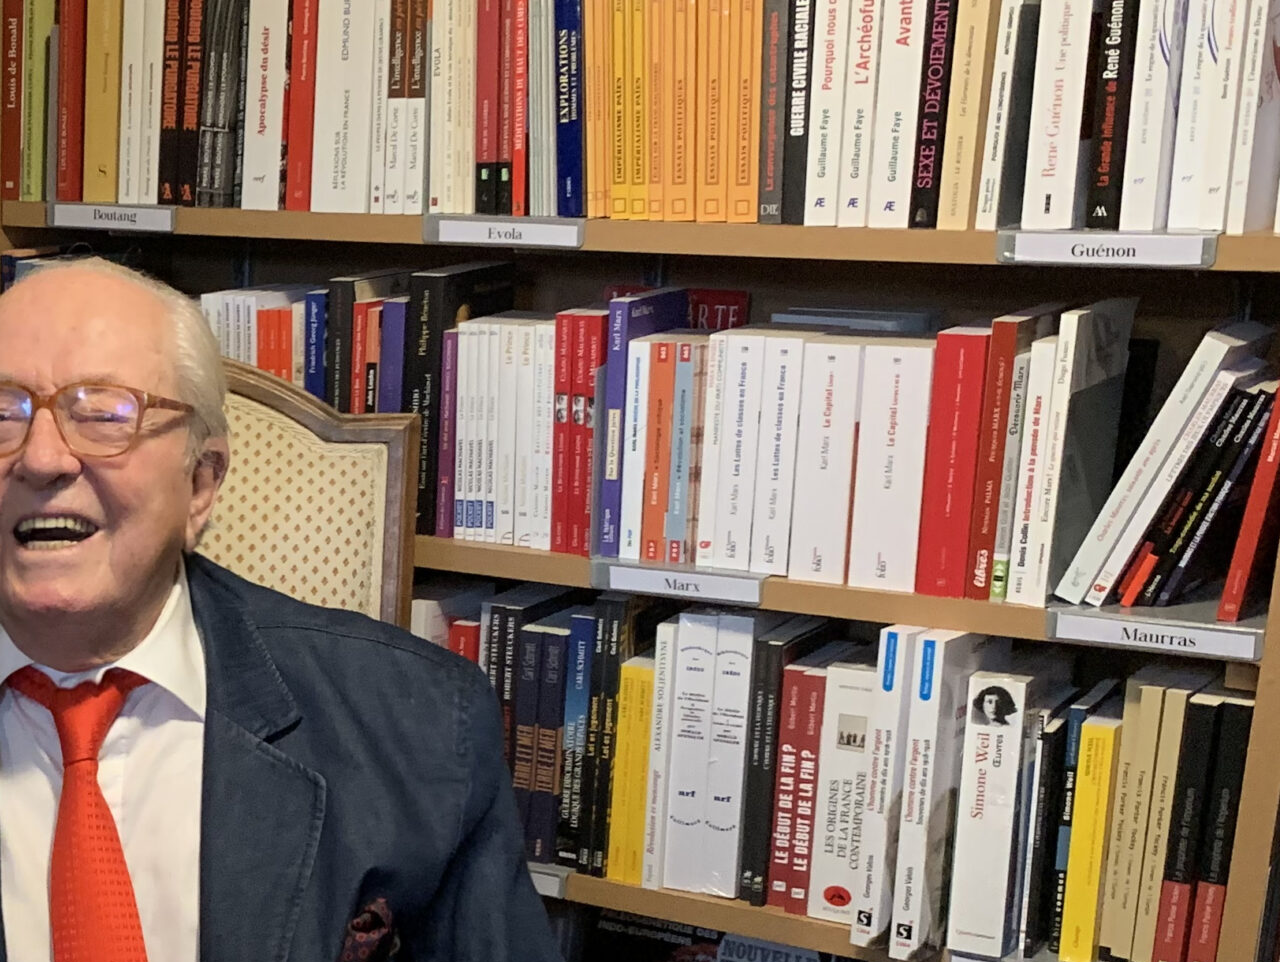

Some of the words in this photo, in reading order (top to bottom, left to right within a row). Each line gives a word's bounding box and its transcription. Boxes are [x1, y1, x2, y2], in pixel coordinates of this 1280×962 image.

[794, 0, 810, 48] RACIALE
[828, 8, 836, 36] nous
[1057, 0, 1076, 46] politique
[1106, 0, 1124, 45] Guénon
[8, 18, 17, 58] Bonald
[261, 26, 270, 54] désir
[8, 61, 17, 74] de
[261, 56, 268, 72] du
[392, 31, 402, 90] L'intelligence
[411, 31, 421, 90] L'intelligence
[792, 50, 807, 89] CIVILE
[821, 39, 836, 91] Pourquoi
[925, 0, 950, 112] DÉVOIEMENT
[1054, 48, 1067, 71] Une
[1102, 48, 1120, 78] René
[555, 29, 572, 123] EXPLORATIONS
[1105, 80, 1117, 92] de
[7, 77, 17, 109] Louis
[257, 75, 268, 136] Apocalypse
[1045, 77, 1066, 137] Guénon
[790, 90, 805, 137] GUERRE
[820, 108, 830, 128] Faye
[892, 111, 902, 131] Faye
[851, 130, 861, 178] Guillaume
[856, 108, 864, 128] Faye
[922, 119, 937, 139] ET
[817, 130, 829, 178] Guillaume
[888, 132, 899, 182] Guillaume
[917, 145, 935, 188] SEXE
[1040, 141, 1059, 178] René
[1098, 140, 1112, 173] Grande
[1097, 175, 1109, 186] La
[93, 209, 137, 223] Boutang
[488, 227, 522, 240] Evola
[1071, 243, 1136, 258] Guénon
[613, 309, 623, 331] Marx
[612, 333, 621, 350] Karl
[1032, 395, 1042, 415] Marx
[1031, 415, 1040, 425] de
[1213, 423, 1233, 447] Charles
[1227, 397, 1249, 424] Maurras
[1027, 427, 1040, 456] pensée
[1027, 457, 1036, 465] la
[1022, 474, 1035, 521] Introduction
[1019, 523, 1029, 542] Collin
[1017, 544, 1027, 567] Denis
[664, 578, 700, 593] Marx
[505, 617, 515, 664] STEUCKERS
[1121, 628, 1197, 648] Maurras
[575, 640, 587, 670] SCHMITT
[503, 667, 512, 699] ROBERT
[574, 672, 584, 689] CARL
[783, 743, 797, 753] ?
[802, 749, 816, 759] ?
[909, 738, 922, 765] l'argent
[975, 732, 990, 765] Weil
[993, 734, 1004, 768] Œuvres
[783, 756, 796, 774] FIN
[801, 762, 815, 780] FIN
[906, 766, 918, 789] contre
[1065, 770, 1074, 788] Weil
[781, 775, 795, 790] LA
[800, 782, 813, 796] LA
[971, 768, 986, 819] Simone
[780, 791, 793, 807] DE
[799, 797, 812, 813] DE
[826, 779, 839, 832] ORIGINES
[840, 779, 853, 826] FRANCE
[901, 790, 916, 822] L'homme
[1061, 790, 1073, 820] Simone
[774, 808, 792, 849] DÉBUT
[849, 771, 867, 870] CONTEMPORAINE
[793, 815, 811, 856] DÉBUT
[824, 835, 833, 854] LES
[838, 829, 847, 842] LA
[774, 850, 788, 864] LE
[793, 857, 807, 871] LE
[837, 846, 846, 858] DE
